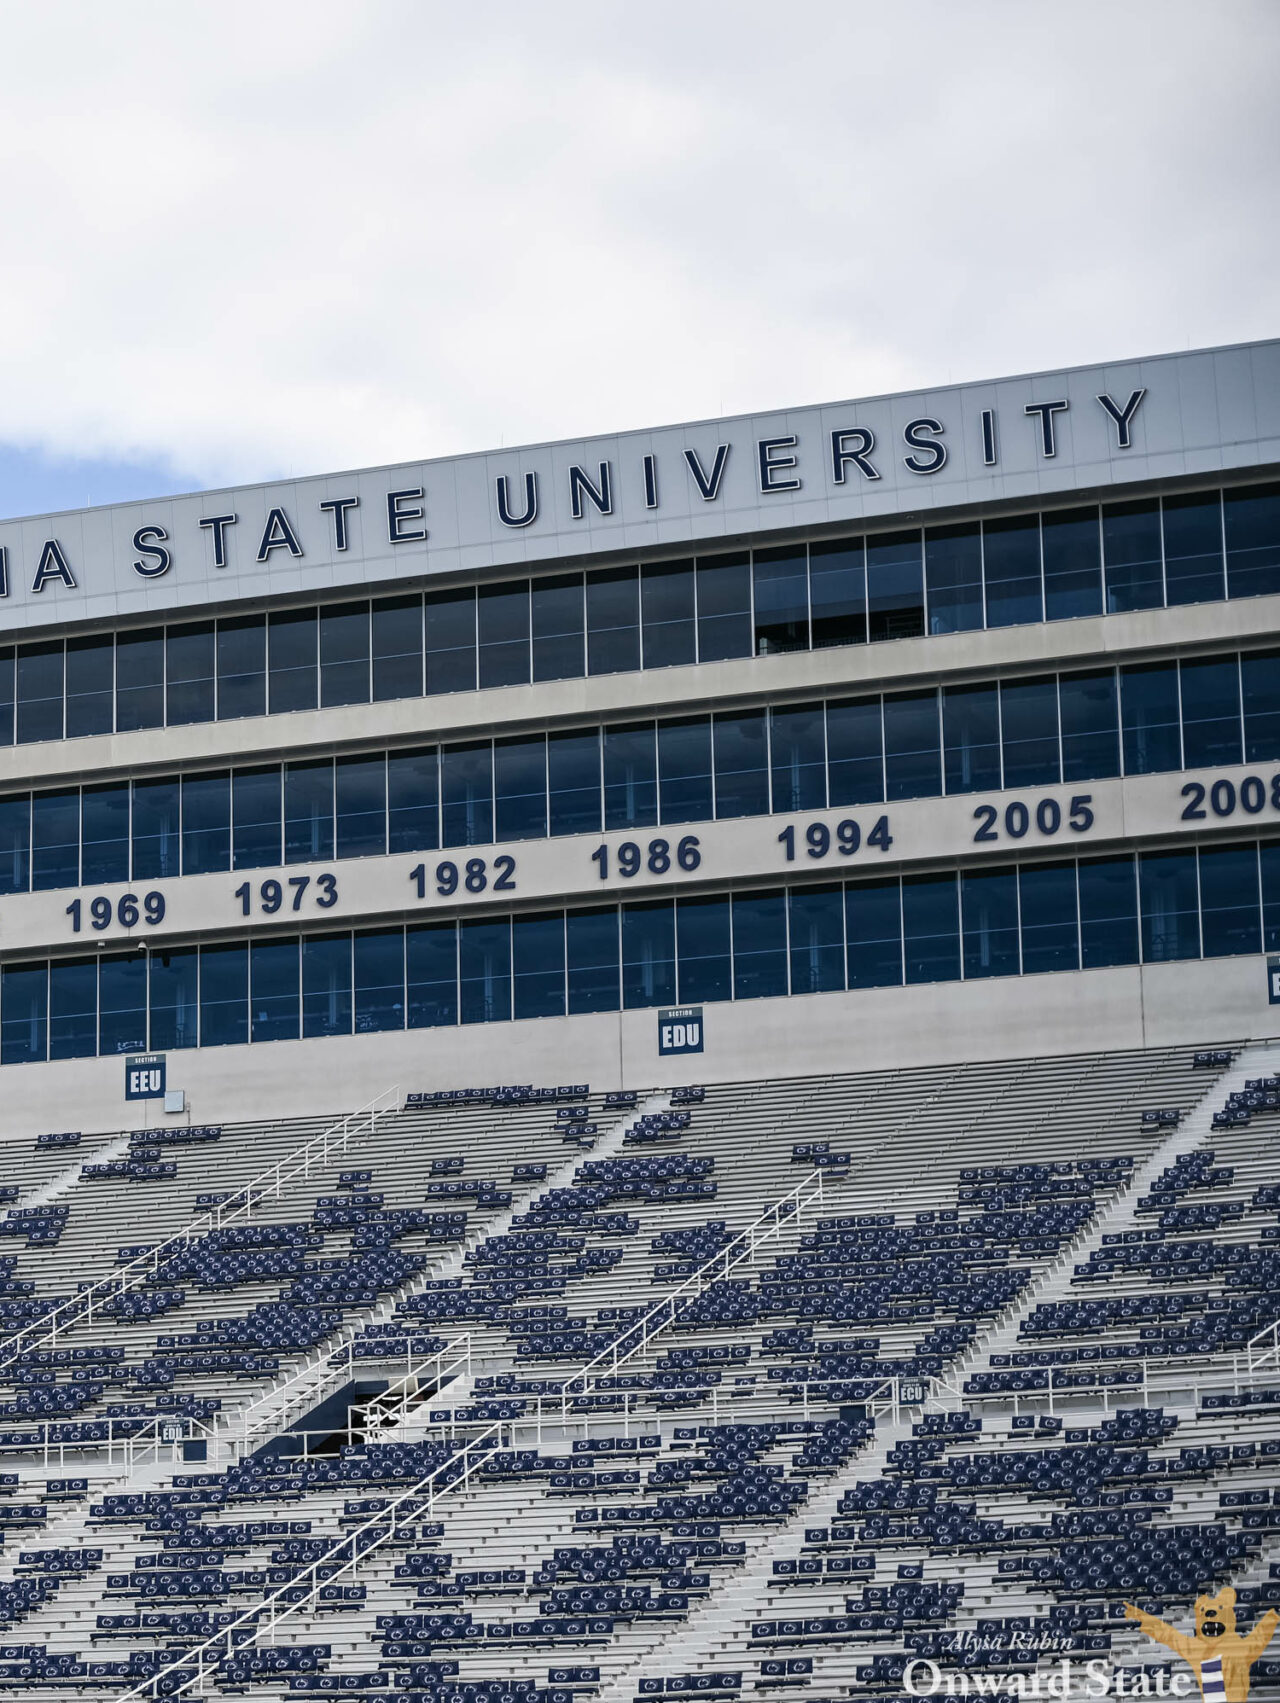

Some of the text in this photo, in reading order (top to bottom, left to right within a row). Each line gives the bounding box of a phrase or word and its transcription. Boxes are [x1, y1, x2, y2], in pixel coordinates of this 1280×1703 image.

[131, 485, 428, 579] STATE
[494, 387, 1148, 529] UNIVERSITY
[65, 890, 167, 933] 1969
[234, 873, 339, 917] 1973
[409, 855, 518, 900] 1982
[591, 835, 702, 880] 1986
[777, 815, 894, 862] 1994
[972, 794, 1095, 843] 2005
[668, 1009, 693, 1018] SECTION
[662, 1023, 700, 1048] EDU
[135, 1056, 157, 1064] SECTION
[130, 1069, 161, 1093] EEU
[900, 1386, 923, 1401] ECU
[162, 1426, 183, 1440] EDU
